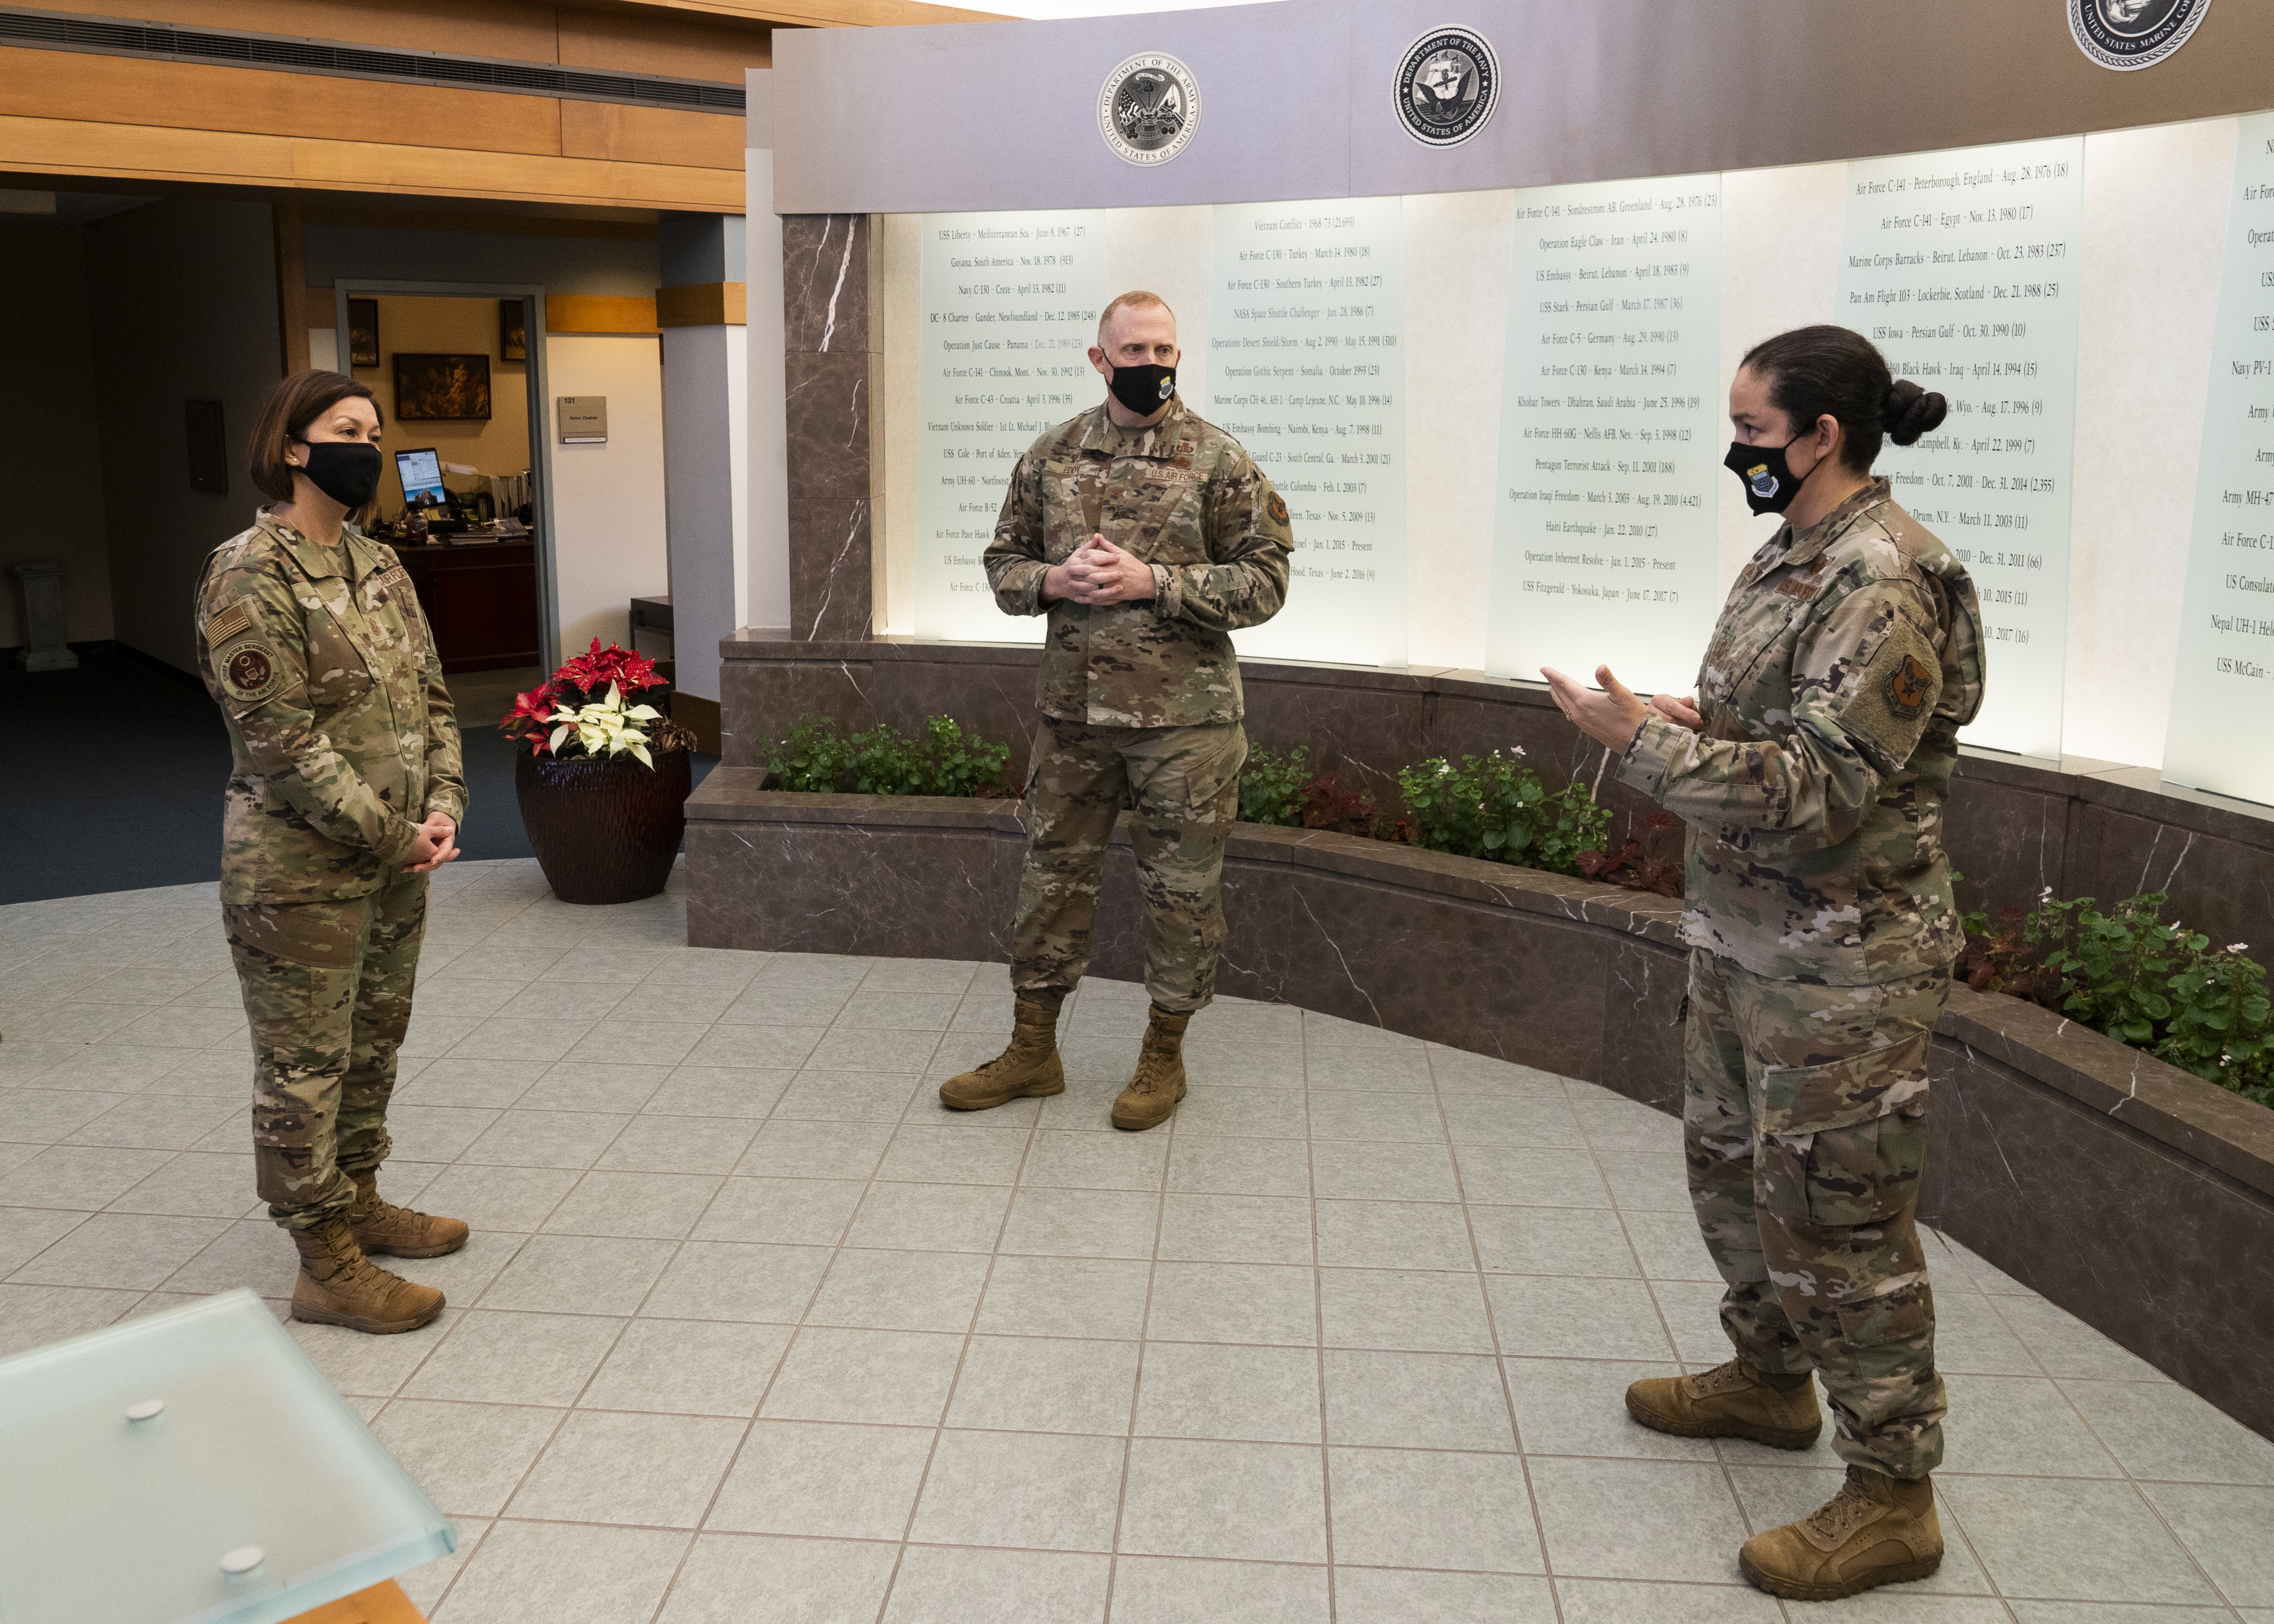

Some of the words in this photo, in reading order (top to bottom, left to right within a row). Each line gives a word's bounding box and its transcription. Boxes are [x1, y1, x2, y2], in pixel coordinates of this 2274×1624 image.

[2084, 4, 2105, 40] UNITED
[2104, 37, 2136, 50] STATES
[2139, 22, 2178, 49] MARINE
[1405, 38, 1449, 83] DEPARTMENT
[1462, 41, 1477, 55] THE
[1476, 52, 1489, 77] NAVY
[1104, 59, 1147, 106] DEPARTMENT
[1167, 63, 1183, 77] THE
[1181, 78, 1196, 104] ARMY
[1403, 97, 1422, 126] UNITED
[1421, 125, 1451, 135] STATES
[1453, 124, 1464, 133] OF
[1465, 90, 1488, 126] AMERICA
[1104, 115, 1122, 149] UNITED
[1123, 148, 1157, 161] STATES
[1160, 148, 1172, 158] OF
[1172, 111, 1196, 151] AMERICA
[1856, 182, 1867, 195] Air
[1868, 181, 1886, 194] Force
[1888, 178, 1906, 193] C-141
[1963, 168, 1993, 189] England
[2001, 169, 2018, 186] Aug.
[2035, 164, 2051, 179] 1976
[2054, 161, 2068, 179] (18)
[938, 229, 950, 241] USS
[951, 229, 970, 242] Liberty
[978, 227, 1018, 240] Mediterranean
[1019, 228, 1029, 239] Sea
[1035, 227, 1049, 241] June
[1057, 226, 1070, 237] 1967
[1074, 226, 1086, 238] (27)
[1539, 237, 1569, 253] Operation
[1571, 235, 1588, 251] Eagle
[1588, 234, 1603, 248] Claw
[1611, 234, 1624, 246] Iran
[1631, 231, 1647, 249] April
[1661, 230, 1676, 243] 1980
[1678, 229, 1688, 244] (8)
[1848, 255, 1872, 268] Marine
[1873, 253, 1893, 270] Corps
[1895, 250, 1924, 266] Barracks
[1958, 247, 1988, 263] Lebanon
[1997, 246, 2011, 261] Oct.
[2027, 244, 2044, 259] 1983
[2046, 241, 2066, 259] (237)
[958, 285, 972, 298] Navy
[973, 284, 990, 295] C-130
[995, 284, 1011, 295] Crete
[1017, 283, 1031, 297] April
[1042, 283, 1054, 294] 1982
[1056, 282, 1066, 295] (11)
[1227, 280, 1236, 291] Air
[1237, 279, 1252, 290] Force
[1253, 278, 1270, 290] C-130
[1276, 277, 1301, 290] Southern
[1303, 276, 1322, 291] Turkey
[1329, 275, 1344, 291] April
[1355, 275, 1369, 287] 1982
[1370, 275, 1382, 288] (27)
[1849, 291, 1862, 304] Pan
[1863, 291, 1875, 303] Am
[1877, 288, 1897, 307] Flight
[1898, 288, 1910, 302] 103
[1954, 284, 1985, 300] Scotland
[1993, 285, 2008, 299] Dec.
[2023, 283, 2041, 298] 1988
[2043, 281, 2059, 299] (25)
[1539, 301, 1552, 314] USS
[1553, 300, 1569, 313] Stark
[1576, 300, 1598, 312] Persian
[1599, 298, 1614, 311] Gulf
[1621, 297, 1641, 311] March
[1654, 297, 1668, 310] 1987
[1670, 296, 1683, 311] (36)
[1225, 365, 1252, 379] Operation
[1253, 365, 1271, 376] Gothic
[1273, 365, 1294, 380] Serpent
[1300, 364, 1323, 377] Somalia
[1329, 364, 1352, 376] October
[1354, 365, 1367, 376] 1993
[1368, 364, 1379, 378] (23)
[2232, 360, 2251, 379] Navy
[2253, 360, 2271, 375] PV-1
[927, 422, 949, 432] Vietnam
[950, 421, 975, 432] Unknown
[976, 421, 994, 432] Soldier
[999, 422, 1007, 432] 1st
[1017, 421, 1037, 432] Michael
[1038, 422, 1044, 434] J.
[1063, 465, 1081, 474] EDDY
[1151, 470, 1164, 478] U.S.
[1165, 471, 1178, 481] AIR
[1179, 472, 1204, 481] FORCE
[1535, 458, 1562, 474] Pentagon
[1563, 459, 1589, 471] Terrorist
[1591, 459, 1611, 472] Attack
[1617, 460, 1630, 475] Sep.
[1641, 461, 1657, 474] 2001
[1658, 460, 1675, 475] (188)
[941, 476, 955, 488] Army
[957, 475, 976, 485] UH-60
[982, 475, 1009, 486] Northwest
[1895, 470, 1924, 485] Freedom
[1932, 473, 1946, 487] Oct.
[1956, 474, 1973, 488] 2001
[1981, 475, 1997, 490] Dec.
[2010, 477, 2028, 491] 2014
[2223, 489, 2243, 508] Army
[2246, 490, 2274, 506] MH-47
[379, 573, 394, 585] AIR
[2226, 574, 2237, 589] US
[2211, 614, 2233, 634] Nepal
[2236, 618, 2256, 634] UH-1
[224, 646, 243, 664] MASTER
[244, 644, 274, 658] SERGEANT
[2217, 657, 2232, 673] USS
[2234, 660, 2263, 678] McCain
[267, 671, 280, 690] FORCE
